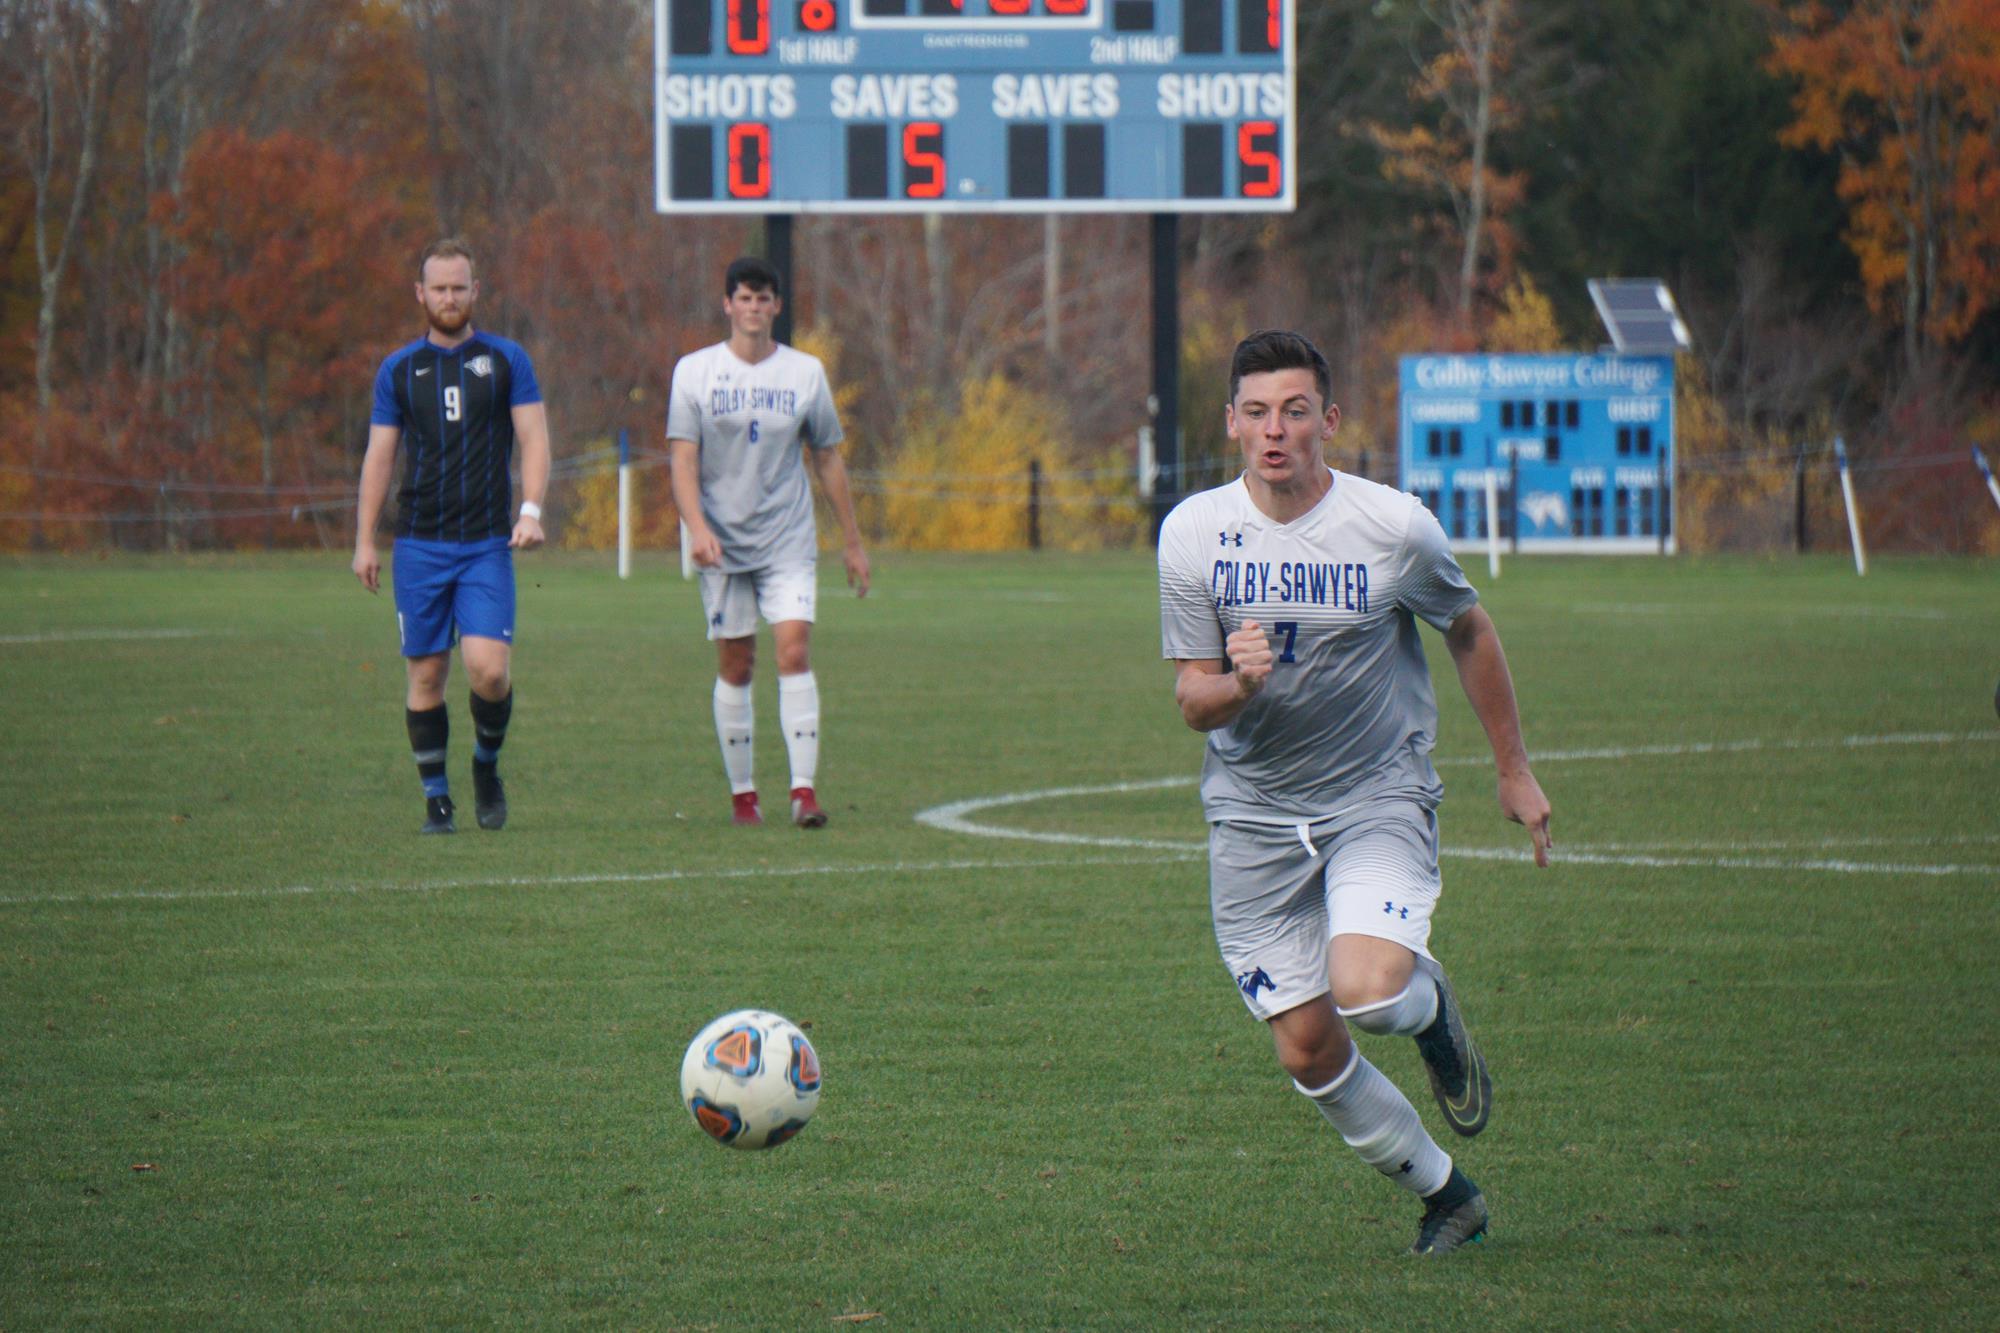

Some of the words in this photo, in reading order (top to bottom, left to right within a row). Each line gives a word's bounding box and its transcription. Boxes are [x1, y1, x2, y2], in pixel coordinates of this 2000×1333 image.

[778, 36, 806, 63] 1st
[808, 36, 857, 63] HALF
[1091, 36, 1126, 63] 2nd
[1128, 36, 1178, 63] HALF
[665, 74, 796, 118] SHOTS
[830, 74, 958, 118] SAVES
[992, 74, 1119, 118] SAVES
[1157, 73, 1284, 118] SHOTS
[729, 123, 769, 197] 0
[904, 123, 945, 197] 5
[1239, 122, 1280, 196] 5
[444, 386, 461, 421] 9
[749, 420, 759, 443] 6
[1212, 559, 1368, 613] COLBY-SAWYER
[1274, 621, 1298, 663] 7
